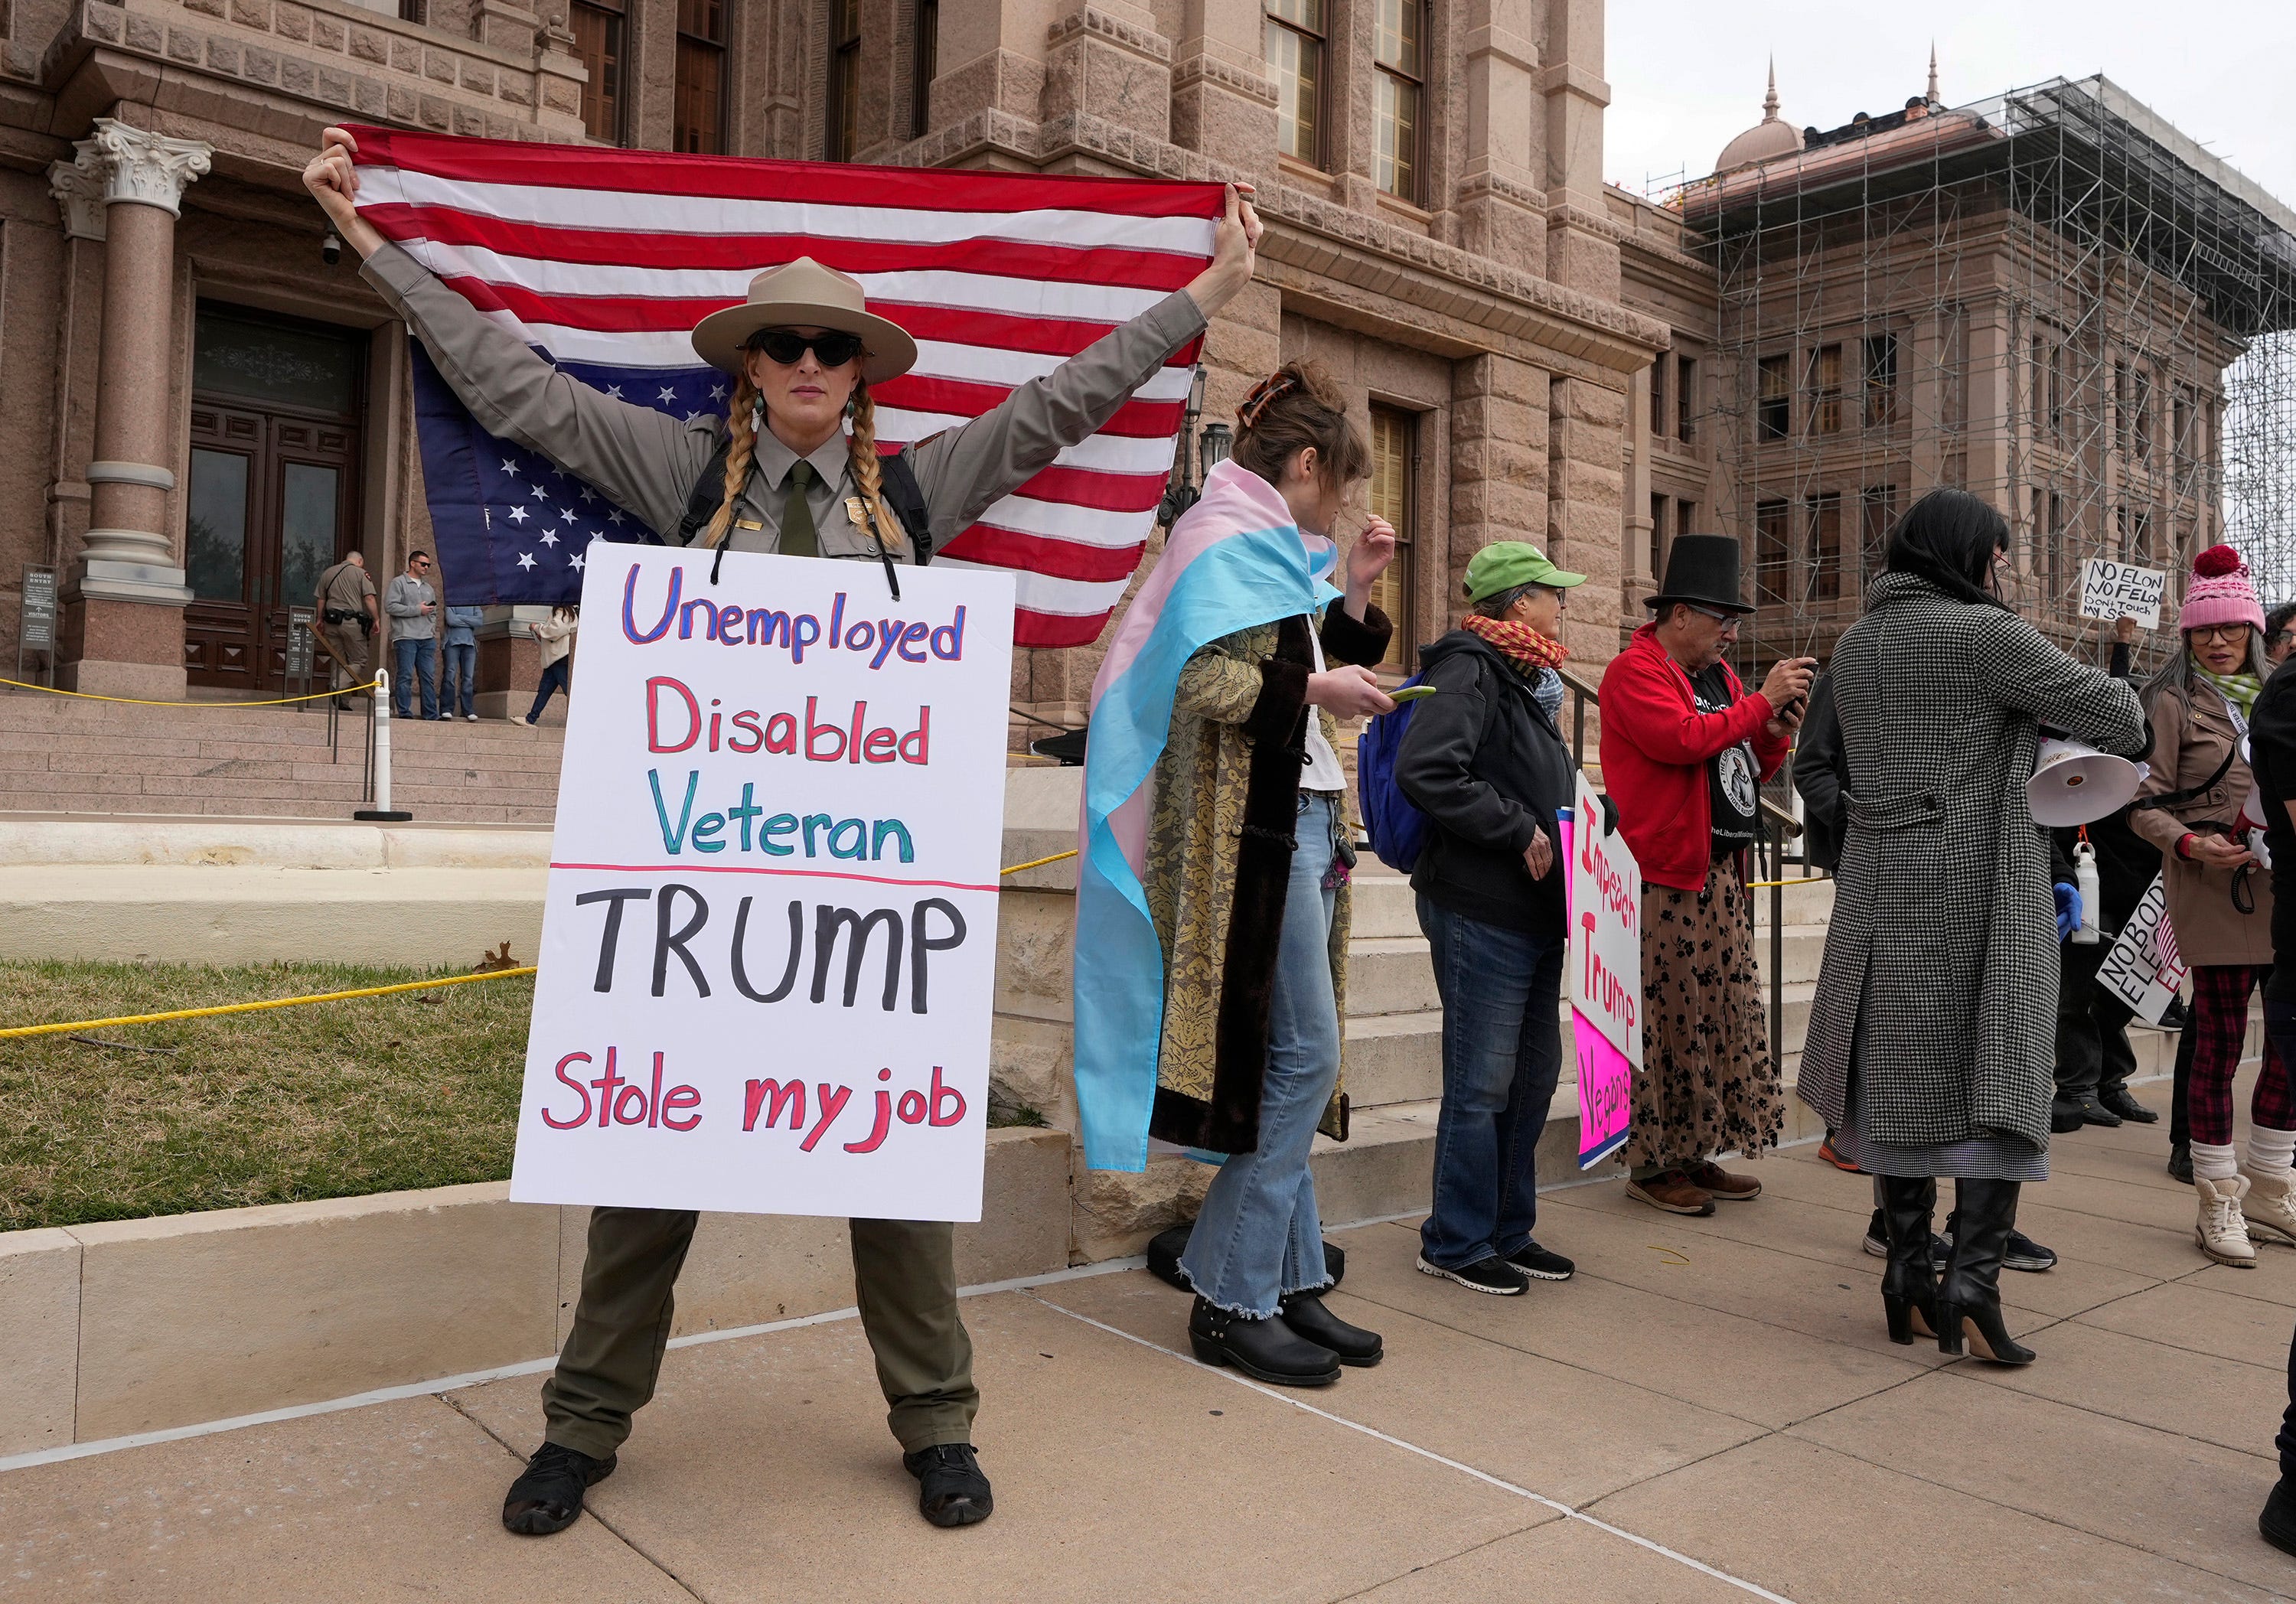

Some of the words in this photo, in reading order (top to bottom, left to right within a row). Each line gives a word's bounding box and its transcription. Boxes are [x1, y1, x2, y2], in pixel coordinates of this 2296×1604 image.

[621, 562, 967, 670] Unemployed
[2085, 580, 2114, 596] NO
[2115, 584, 2164, 607] FELON
[2089, 560, 2117, 582] NO
[2120, 568, 2163, 589] ELON
[2103, 608, 2126, 622] SS
[645, 676, 931, 766] Disabled
[647, 768, 915, 864] Veteran
[1581, 794, 1637, 937] Impeach
[576, 883, 968, 1016] TRUMP
[1581, 911, 1636, 1053] Trump
[2101, 876, 2167, 986] NOBOD
[541, 1045, 703, 1133] Stole
[742, 1077, 853, 1152] my
[842, 1065, 968, 1155] job
[1580, 1045, 1629, 1140] Vegans
